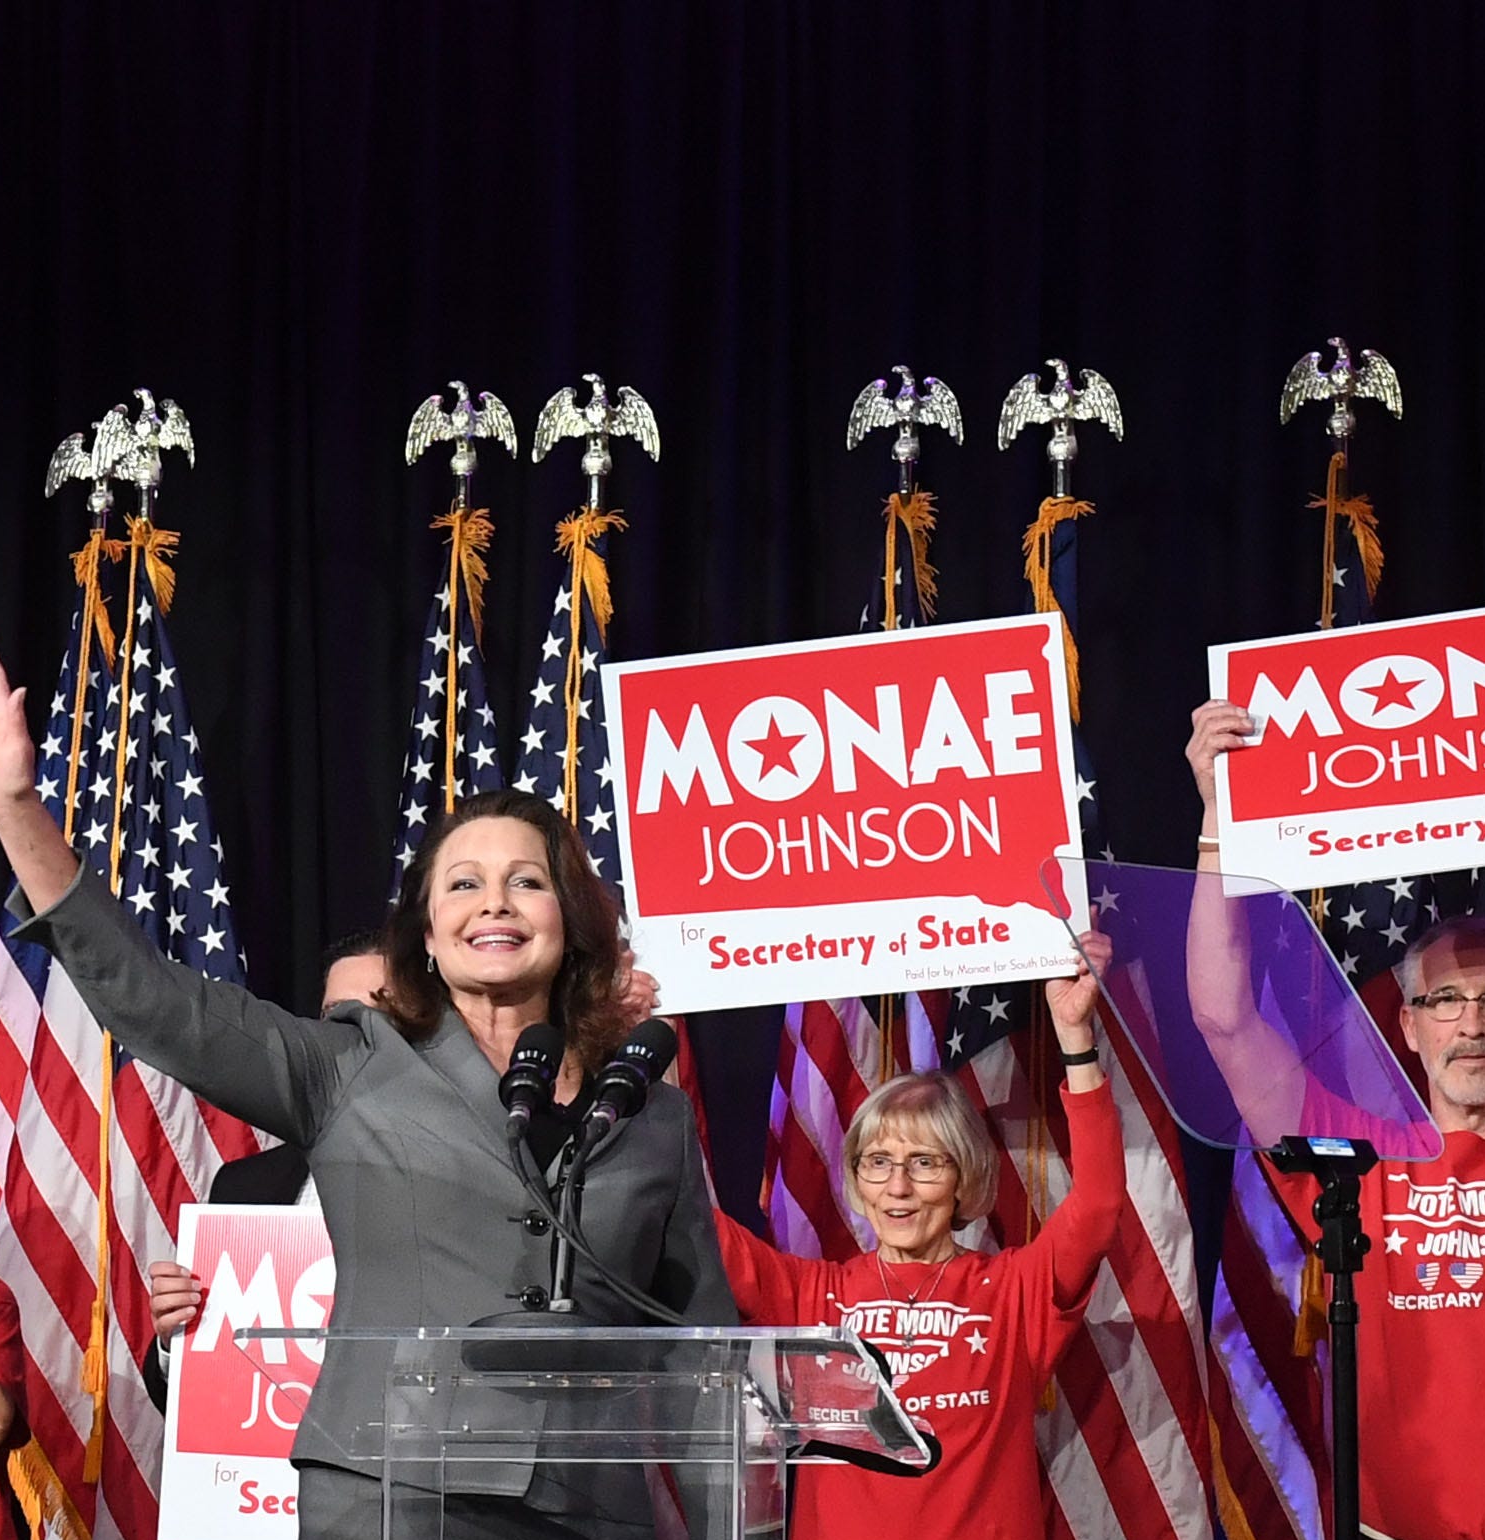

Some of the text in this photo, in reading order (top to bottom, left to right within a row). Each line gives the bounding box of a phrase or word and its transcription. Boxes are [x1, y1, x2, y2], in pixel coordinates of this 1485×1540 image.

[636, 669, 1043, 814] MONAE
[698, 796, 1002, 886] JOHNSON
[1278, 821, 1306, 841] for
[680, 914, 1011, 970] for Secretary of State
[905, 968, 925, 980] Paid
[927, 966, 941, 980] for
[943, 965, 955, 978] by
[994, 961, 1007, 974] for
[1010, 958, 1038, 971] South
[1040, 955, 1077, 968] Dakota
[1407, 1184, 1456, 1218] VOTE
[894, 1309, 965, 1337] MONA
[905, 1397, 931, 1412] OF
[935, 1390, 990, 1410] STATE
[215, 1462, 240, 1486] for
